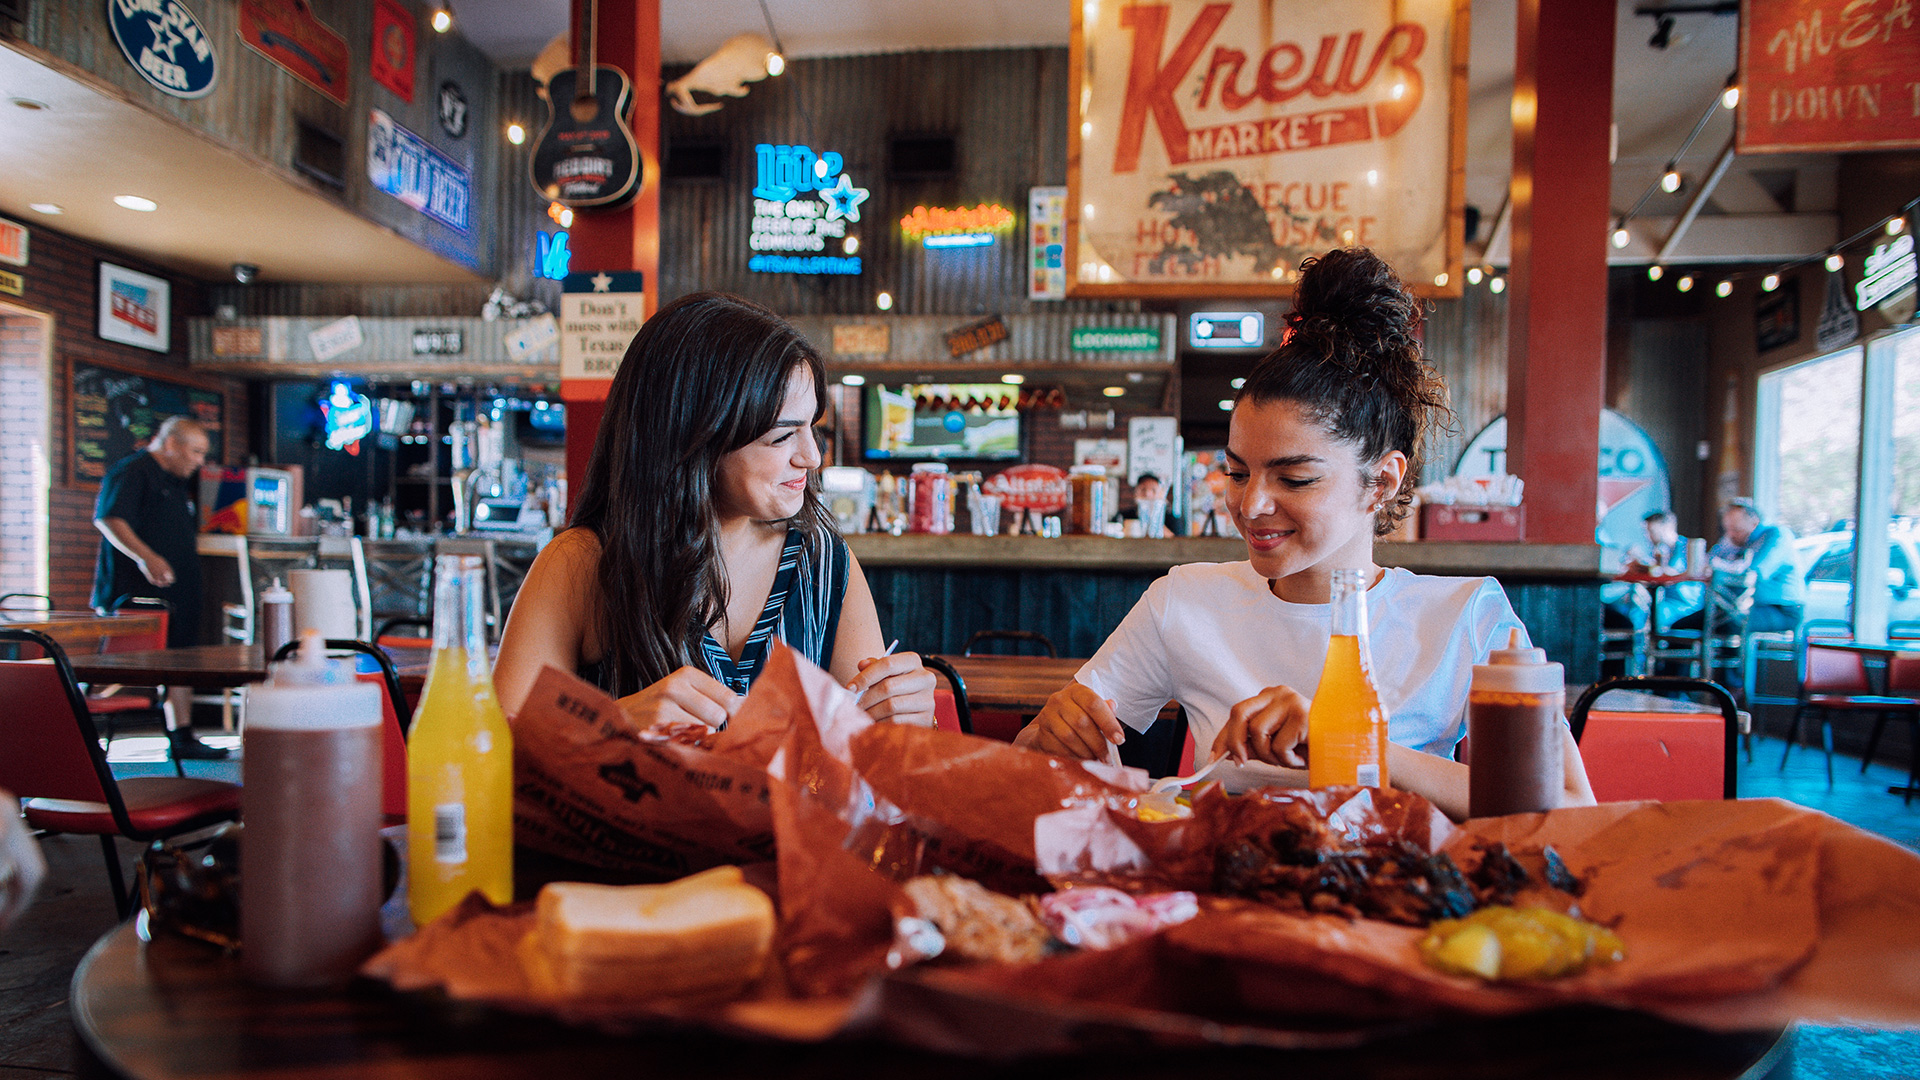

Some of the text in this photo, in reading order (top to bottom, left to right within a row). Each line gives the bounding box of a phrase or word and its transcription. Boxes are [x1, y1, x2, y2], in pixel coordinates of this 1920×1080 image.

[167, 2, 210, 63] STAR
[140, 45, 188, 90] BEER
[1770, 84, 1881, 124] DOWN
[1187, 112, 1346, 160] MARKET
[580, 300, 627, 317] Don't
[566, 319, 640, 333] mess with
[580, 336, 624, 352] Texas
[583, 357, 621, 373] BBQ
